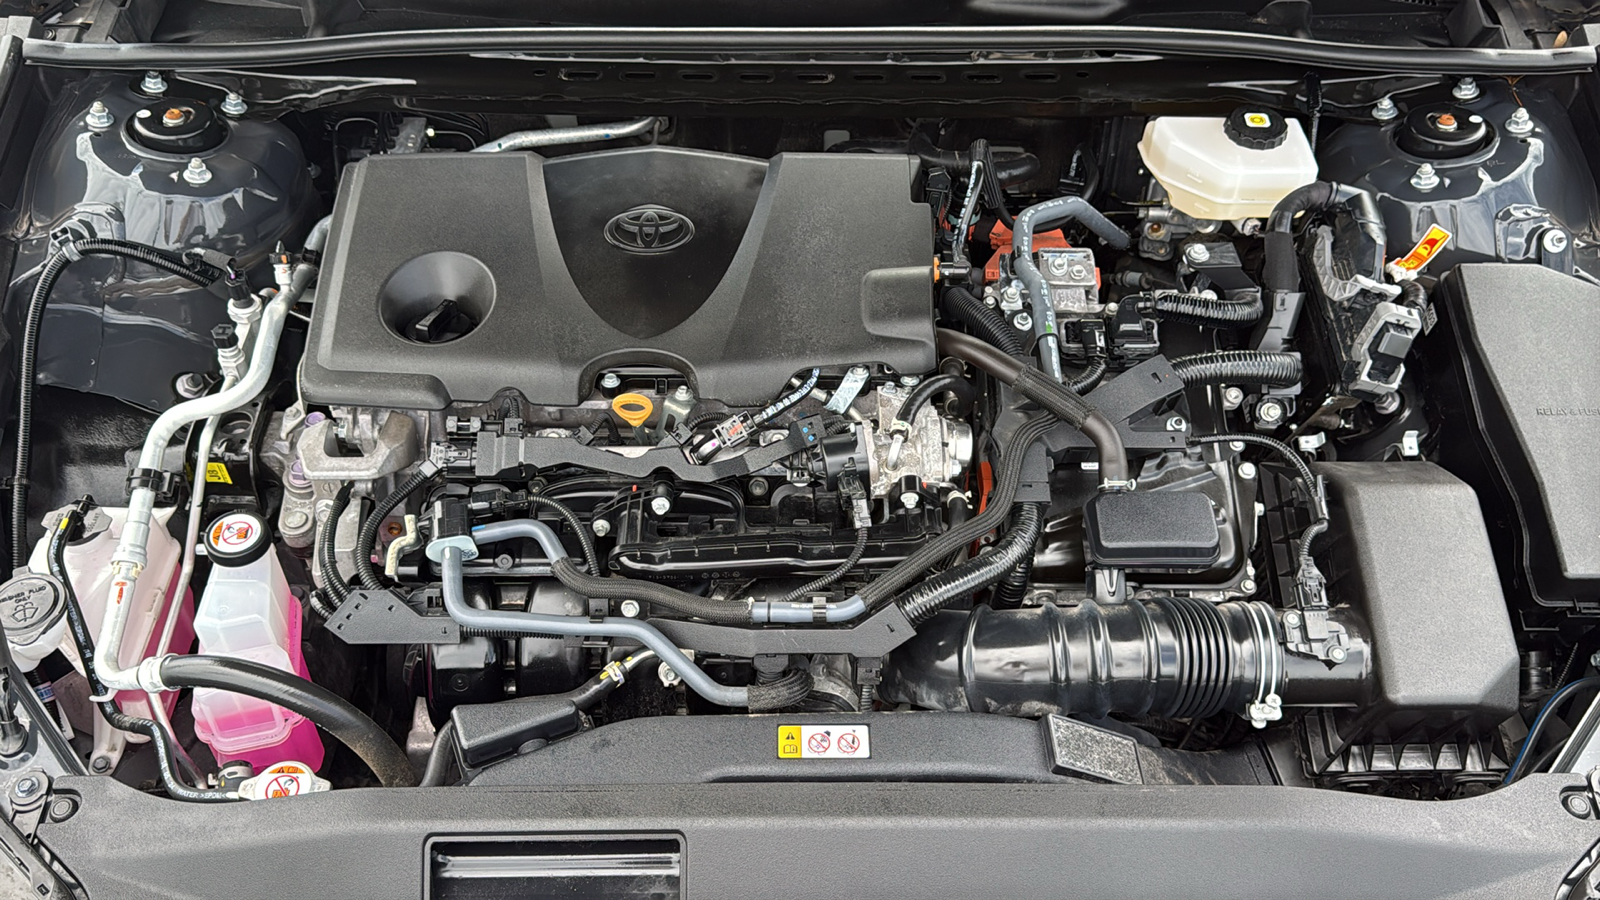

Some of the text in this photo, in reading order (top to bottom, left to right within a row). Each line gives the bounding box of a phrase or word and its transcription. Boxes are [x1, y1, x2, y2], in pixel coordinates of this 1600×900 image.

[1536, 407, 1567, 416] RELAY
[207, 469, 221, 480] J8
[28, 585, 47, 595] FLUID
[14, 595, 32, 604] ONLY
[176, 788, 199, 799] WATER
